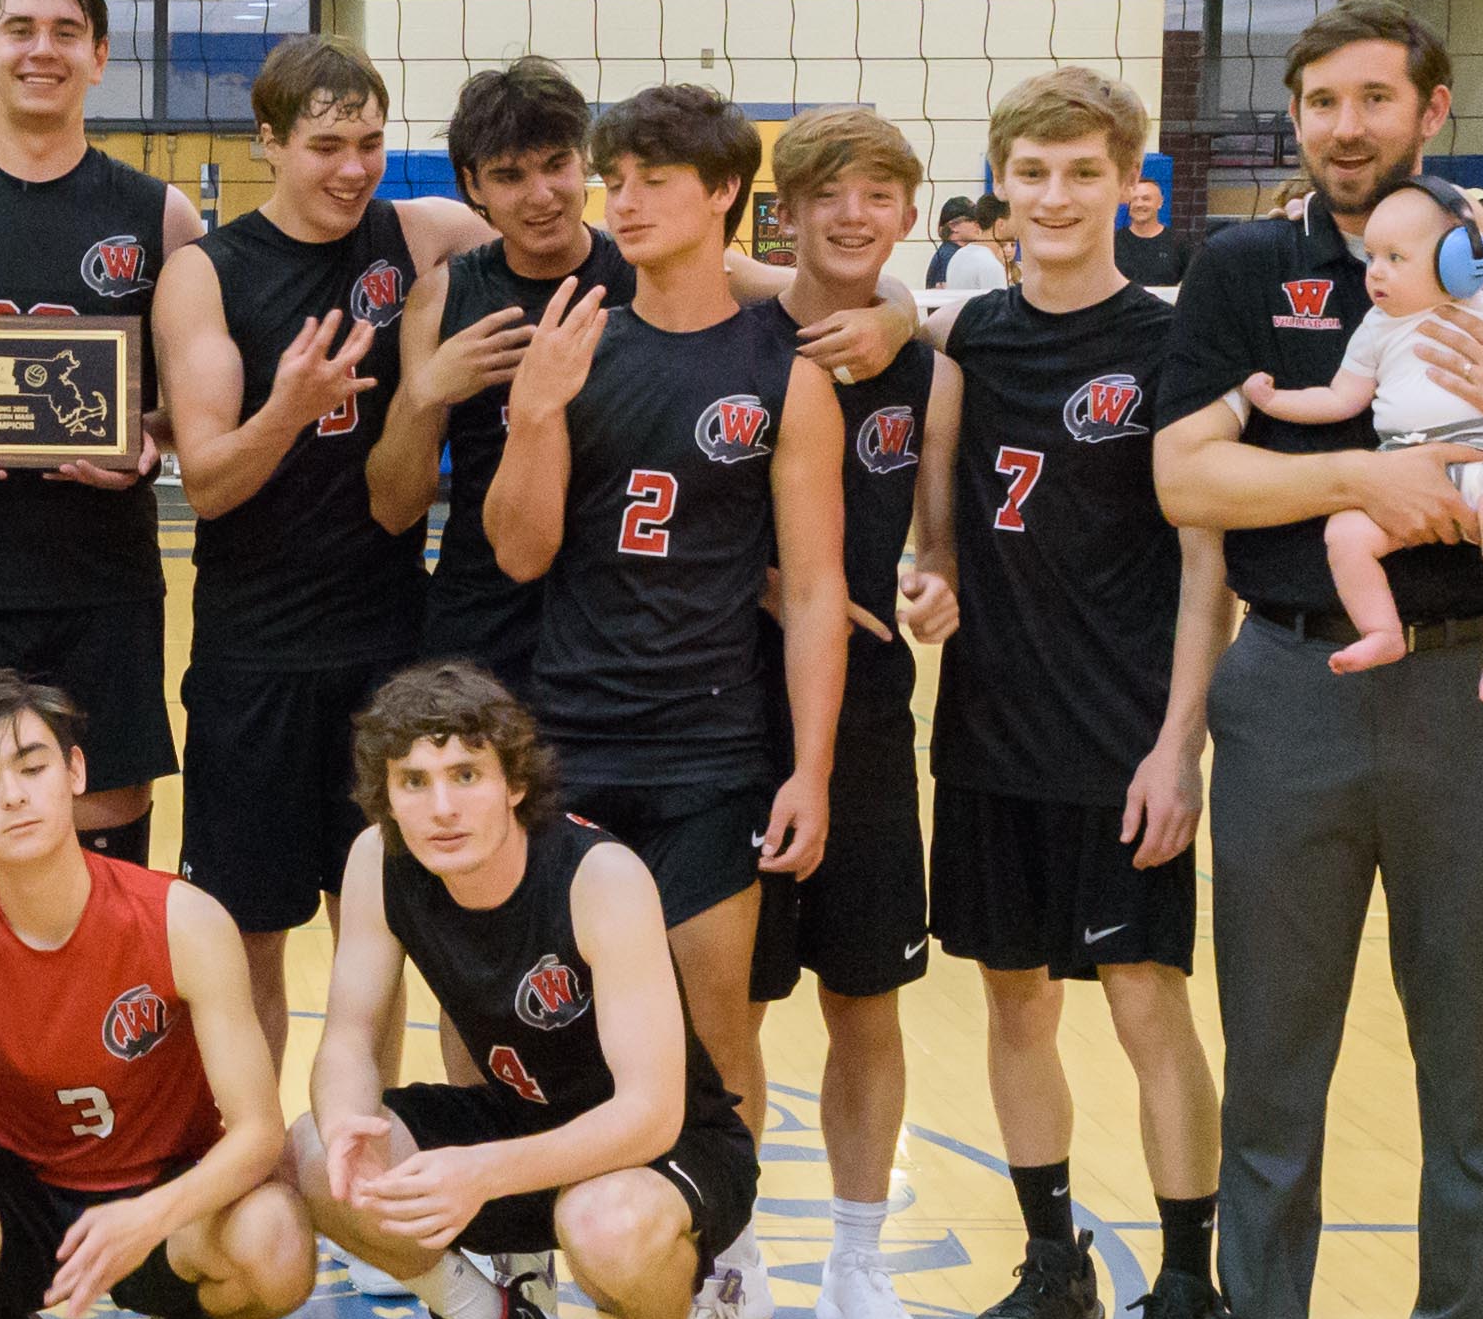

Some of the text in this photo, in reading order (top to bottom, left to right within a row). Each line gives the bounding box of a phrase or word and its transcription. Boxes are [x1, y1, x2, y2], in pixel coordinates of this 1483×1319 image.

[1282, 279, 1334, 317] W
[618, 470, 678, 558] 2
[994, 446, 1045, 532] 7
[57, 1086, 116, 1140] 3
